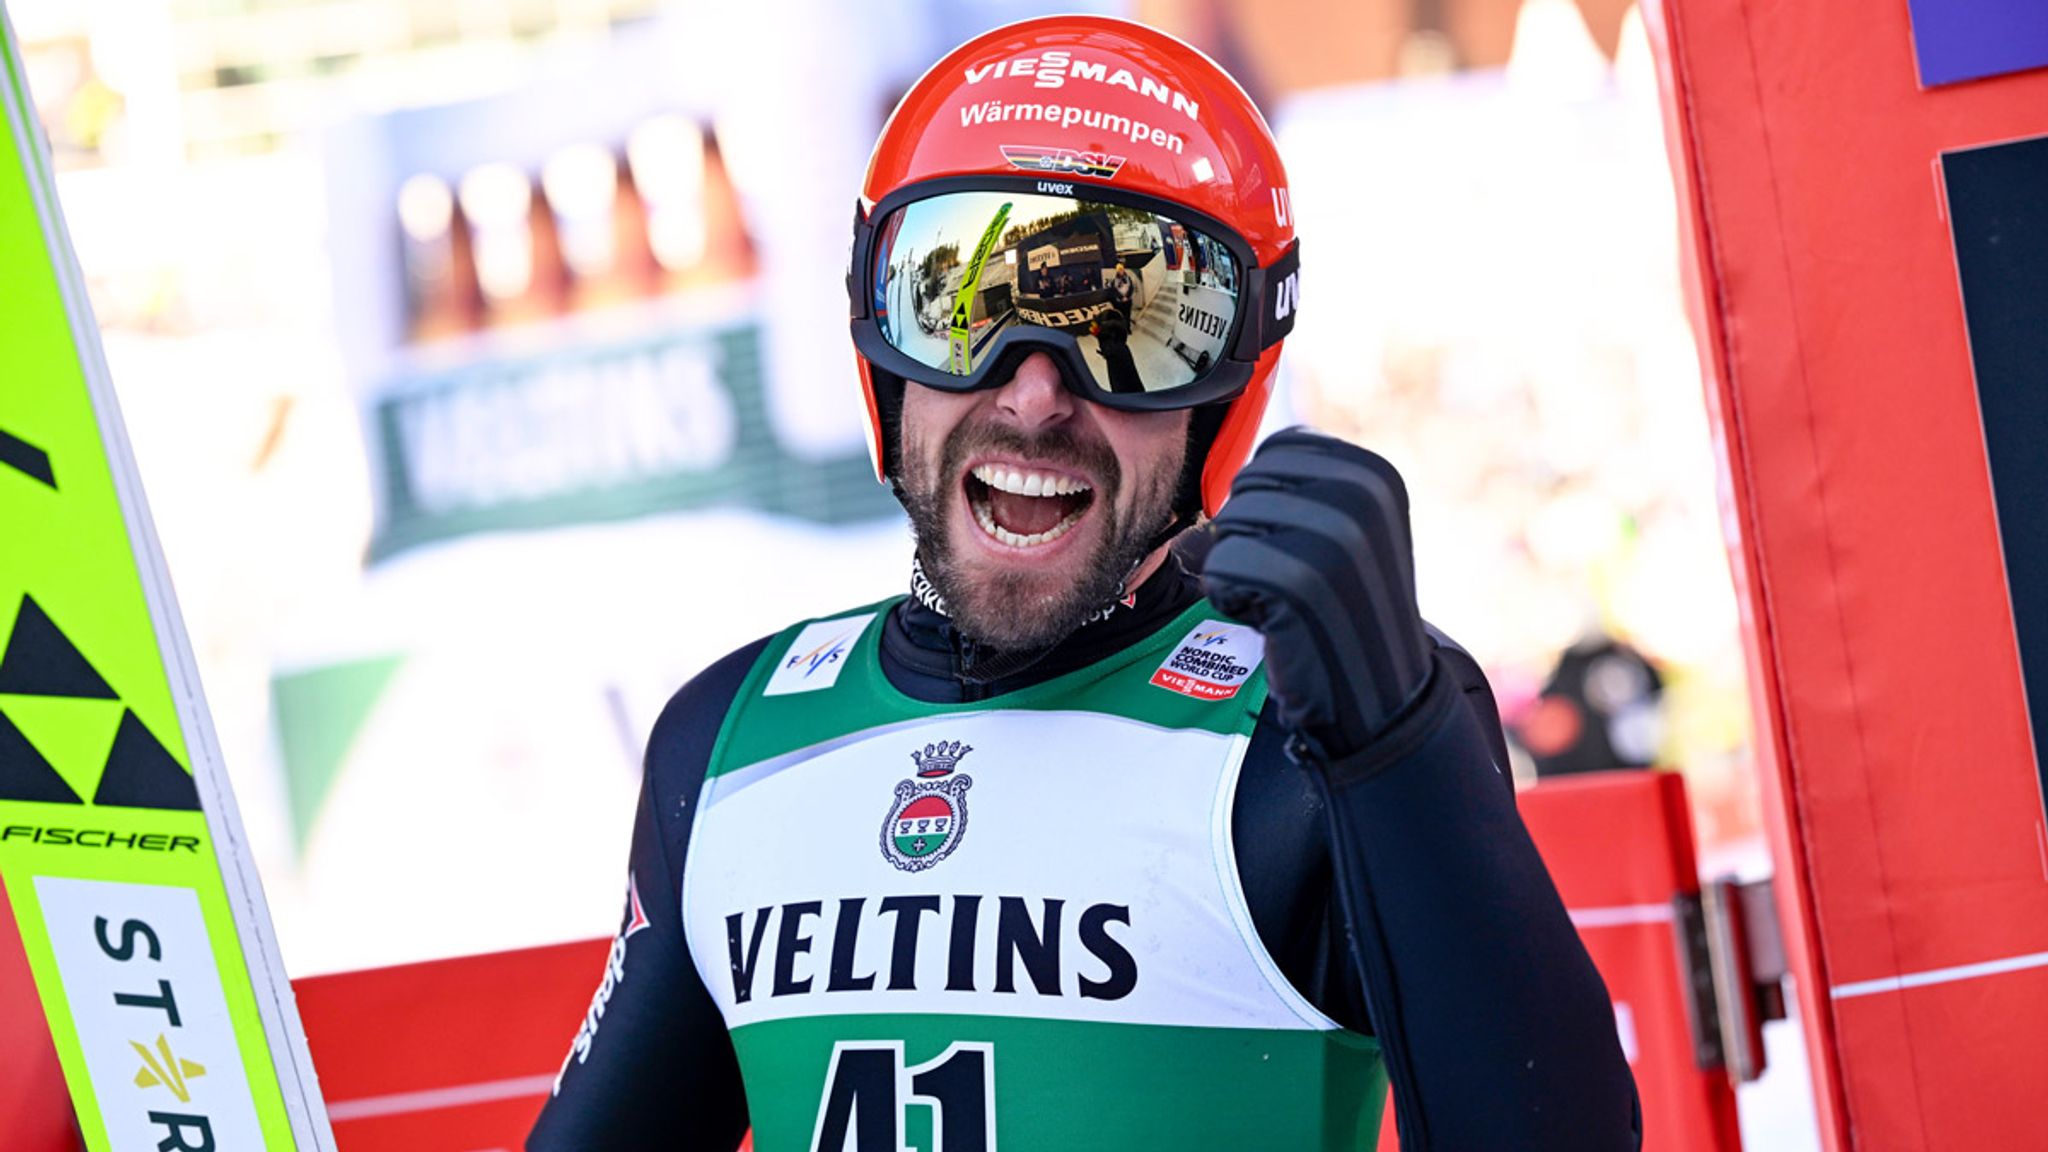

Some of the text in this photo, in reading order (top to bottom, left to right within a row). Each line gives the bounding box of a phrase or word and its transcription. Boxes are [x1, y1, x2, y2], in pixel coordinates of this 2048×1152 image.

[963, 51, 1200, 121] VIESSMANN
[960, 100, 1184, 155] Wärmepumpen
[1053, 149, 1128, 180] DSV
[1037, 181, 1075, 195] uvex
[786, 648, 845, 669] FIS
[1175, 654, 1249, 676] COMBINED
[1181, 646, 1237, 665] NORDIC
[1170, 660, 1235, 682] WORLD CUP
[1, 826, 201, 854] FISCHER
[726, 894, 1139, 1005] VELTINS
[811, 1040, 995, 1152] 41
